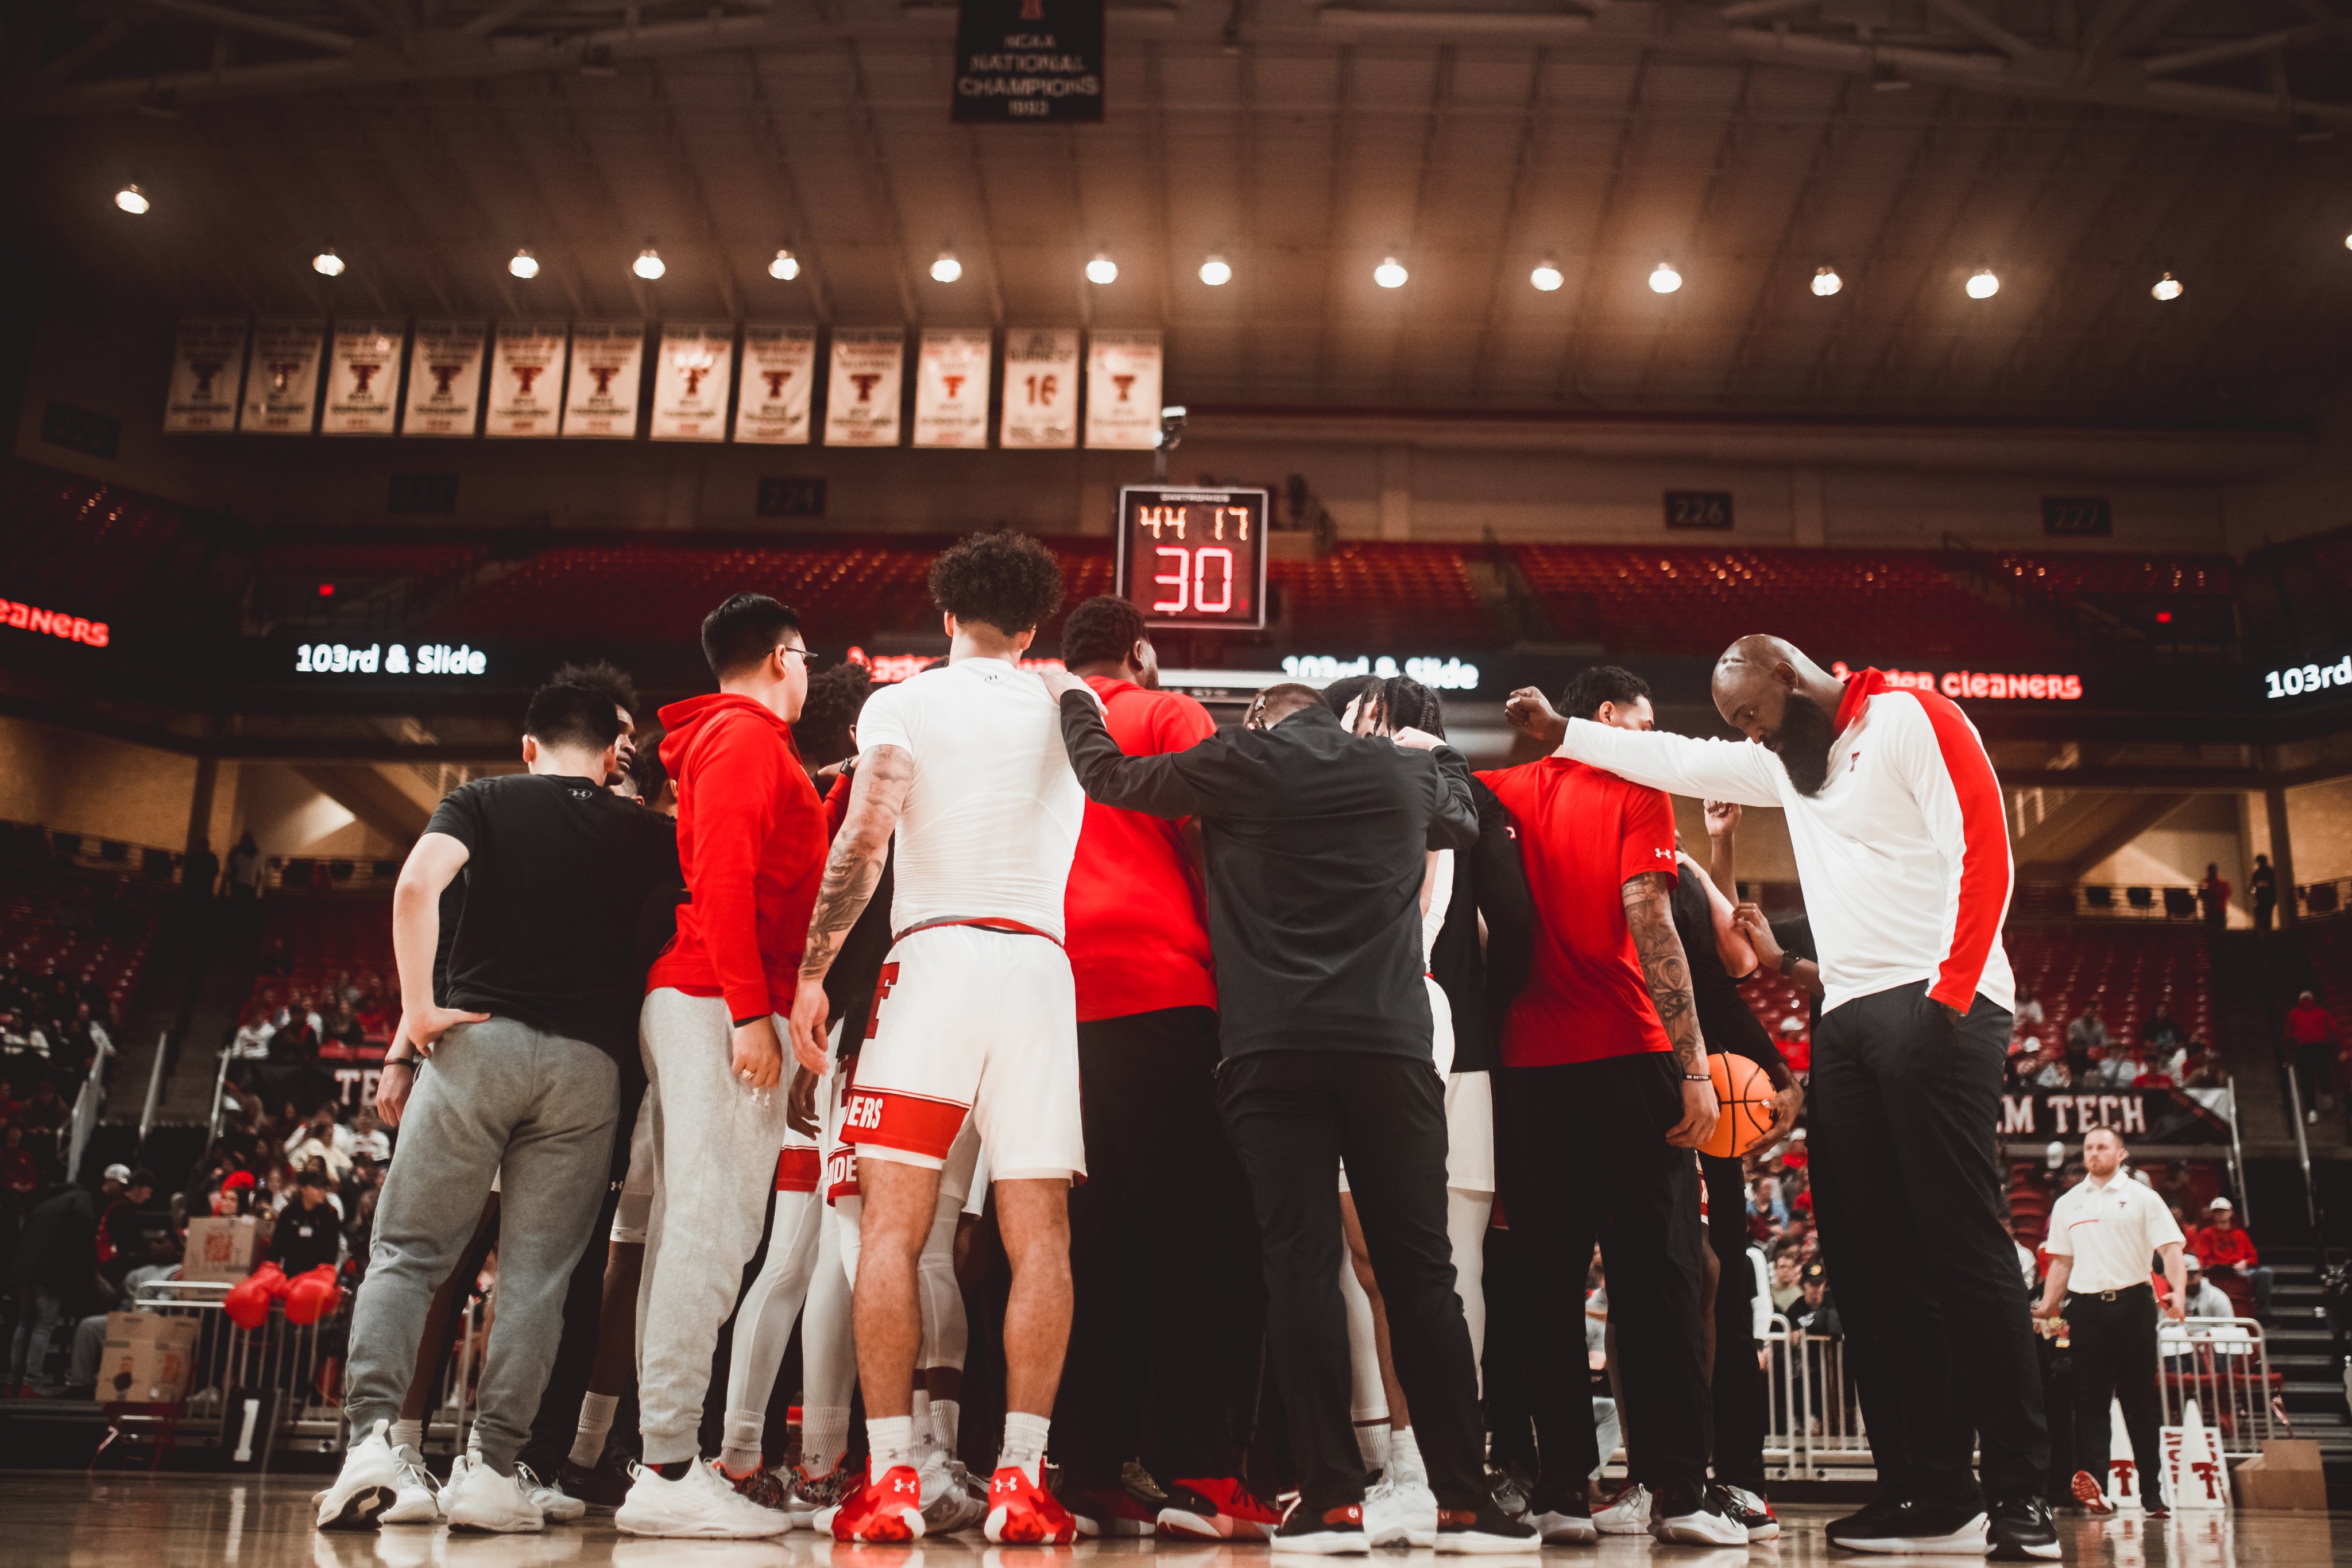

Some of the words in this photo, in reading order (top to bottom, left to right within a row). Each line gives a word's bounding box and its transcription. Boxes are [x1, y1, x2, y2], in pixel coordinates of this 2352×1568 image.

[1004, 33, 1056, 48] NCAA
[970, 53, 1087, 72] NATIONAL
[958, 75, 1100, 96] CHAMPIONS
[1024, 373, 1058, 406] 16
[1140, 506, 1186, 539] 44
[1214, 506, 1248, 540] 17
[1675, 499, 1724, 524] 226
[2054, 506, 2100, 529] 227
[1152, 545, 1233, 613] 30
[296, 643, 380, 673] 103rd
[385, 644, 410, 673] &
[416, 644, 487, 674] Slide
[1405, 656, 1479, 689] Slide
[2265, 655, 2352, 698] 103rd
[844, 1096, 883, 1129] ERS
[1996, 1095, 2034, 1133] M
[2047, 1095, 2146, 1133] TECH
